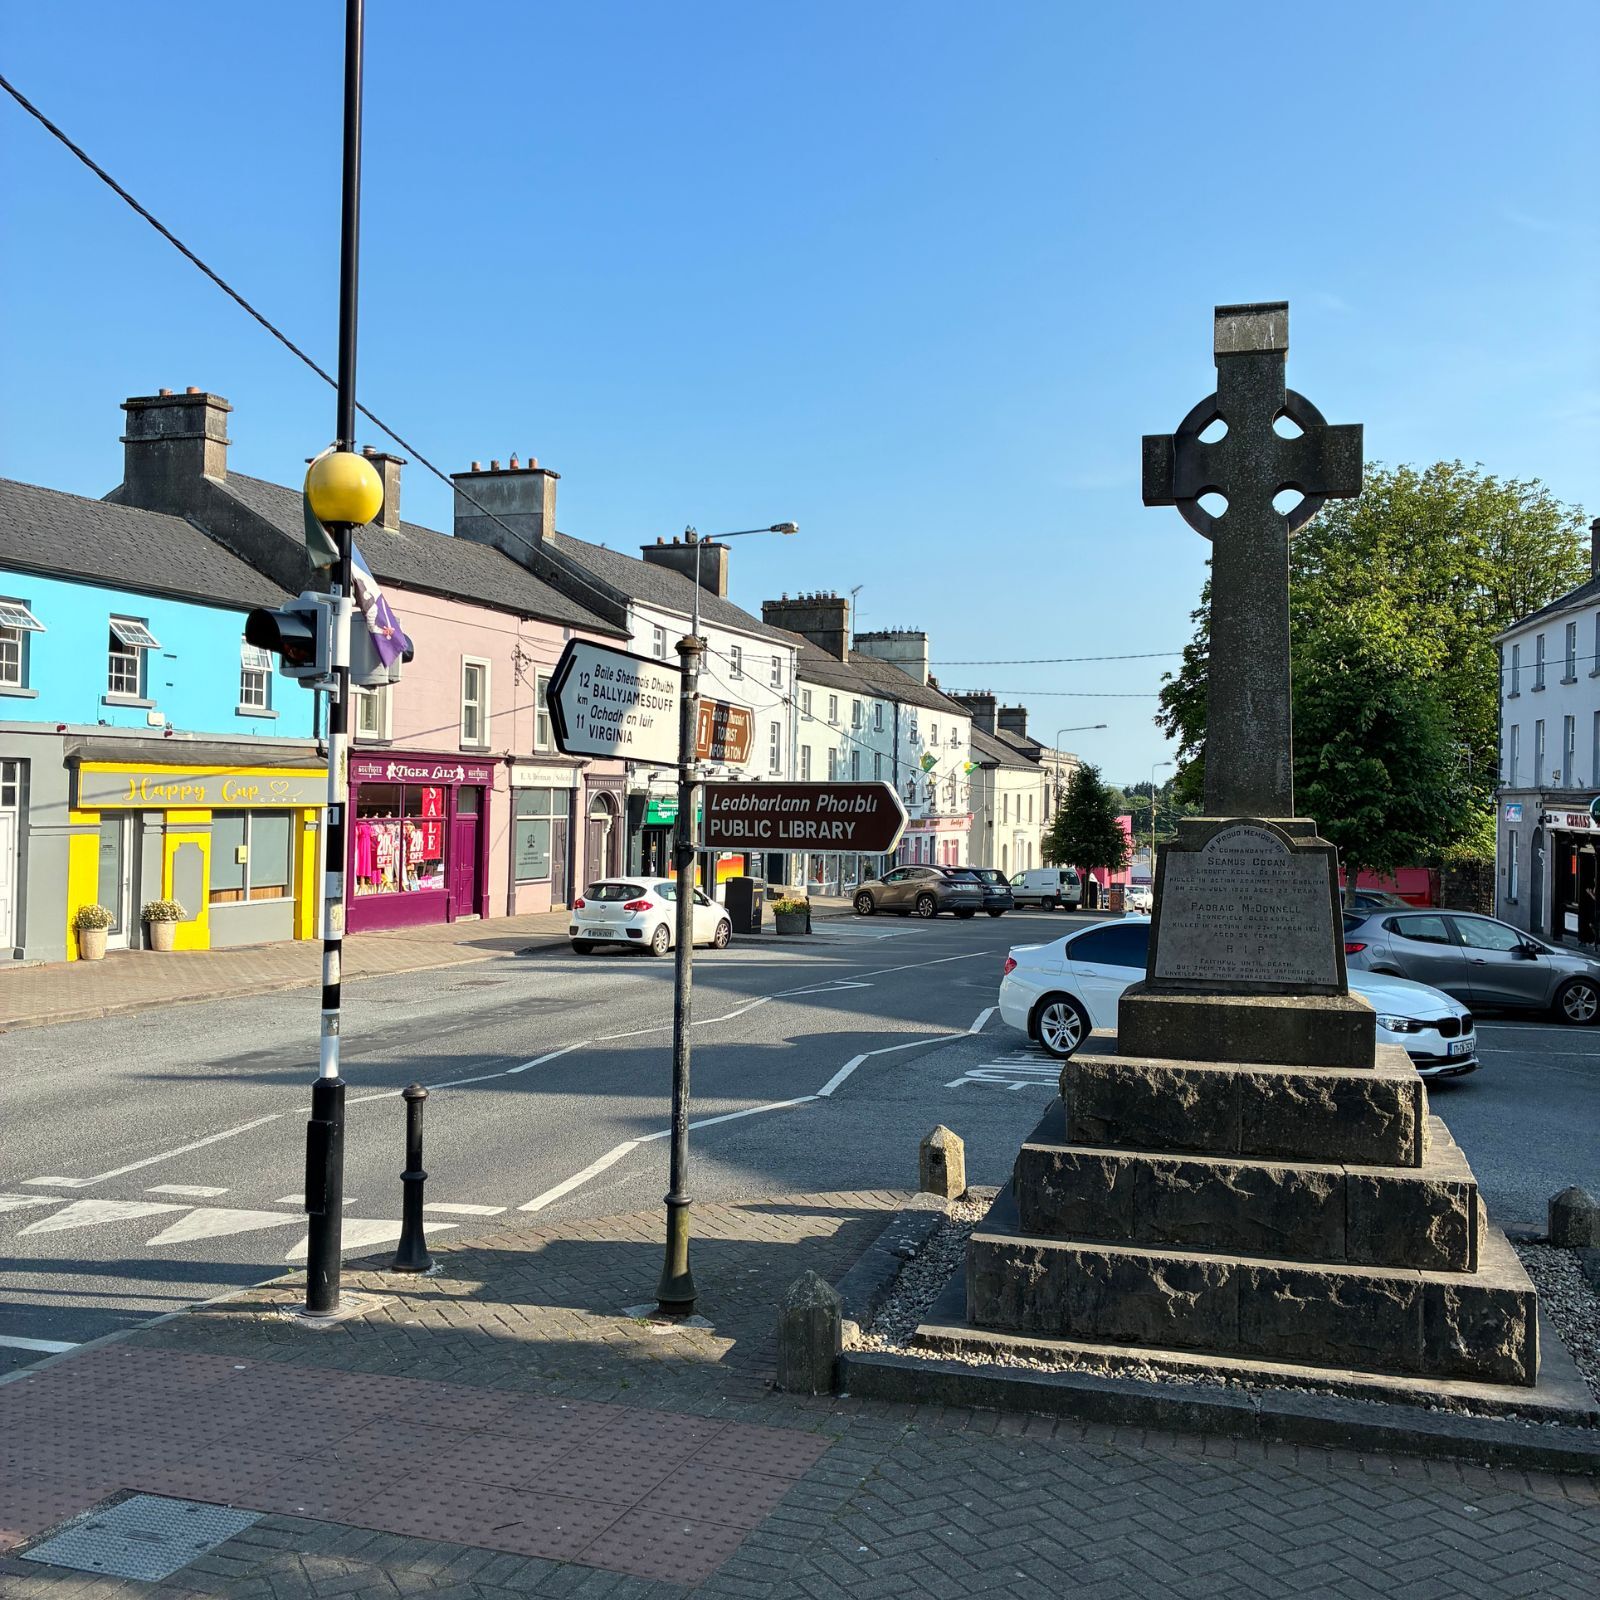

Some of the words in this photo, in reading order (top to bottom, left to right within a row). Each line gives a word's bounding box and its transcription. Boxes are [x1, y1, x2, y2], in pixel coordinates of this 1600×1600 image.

[579, 671, 590, 688] 12
[594, 663, 614, 681] Baile
[651, 677, 674, 694] Dhuibh
[577, 693, 589, 706] km
[592, 683, 674, 713] BALLYJAMESDUFF
[576, 713, 585, 729] 11
[626, 714, 637, 726] an
[589, 723, 633, 744] VIRGINIA
[396, 765, 429, 778] TIGER
[431, 766, 457, 779] LILY
[122, 777, 207, 801] Happy
[222, 778, 259, 802] Cup
[711, 793, 811, 812] Leabharlann
[427, 787, 437, 850] SALE
[710, 819, 772, 838] PUBLIC
[779, 820, 856, 840] LIBRARY
[1207, 845, 1216, 854] IN
[1216, 830, 1241, 845] PROUD
[1243, 829, 1275, 844] MEMORY
[1274, 844, 1285, 854] OF
[376, 855, 392, 865] OFF
[1207, 856, 1246, 866] SEAMUS
[1191, 902, 1235, 912] PADRAIC
[1226, 944, 1234, 953] R
[1257, 945, 1265, 954] P
[1200, 957, 1237, 966] FAITHFUL
